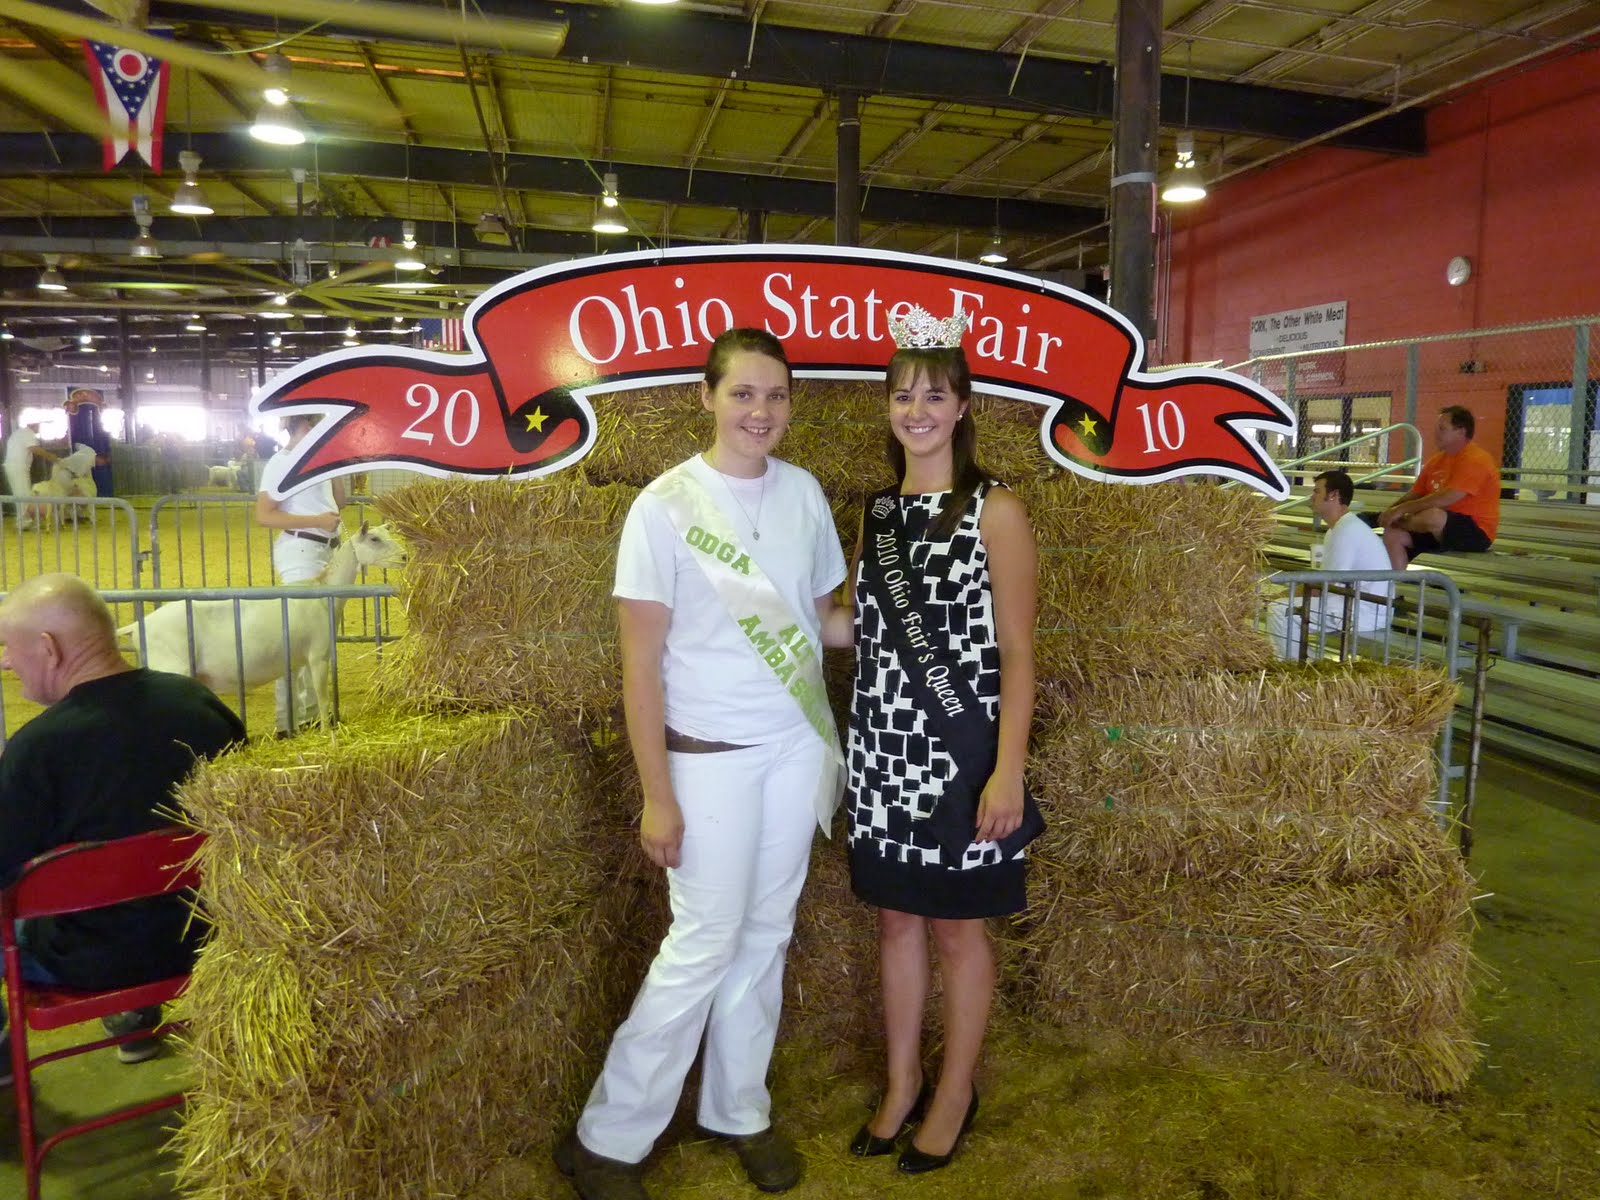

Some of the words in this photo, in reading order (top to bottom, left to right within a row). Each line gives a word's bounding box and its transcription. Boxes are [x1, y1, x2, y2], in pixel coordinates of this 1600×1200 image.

[569, 277, 734, 364] Ohio
[949, 288, 1062, 373] Fair
[1271, 318, 1281, 330] The
[1283, 315, 1301, 328] Other
[1304, 311, 1323, 325] White
[1325, 307, 1344, 321] Meat
[400, 383, 480, 447] 20
[1136, 400, 1186, 454] 10
[685, 525, 751, 576] ODGA
[875, 528, 900, 566] 2010
[884, 569, 911, 609] Ohio
[901, 611, 939, 664] Fair's
[925, 665, 966, 718] Queen
